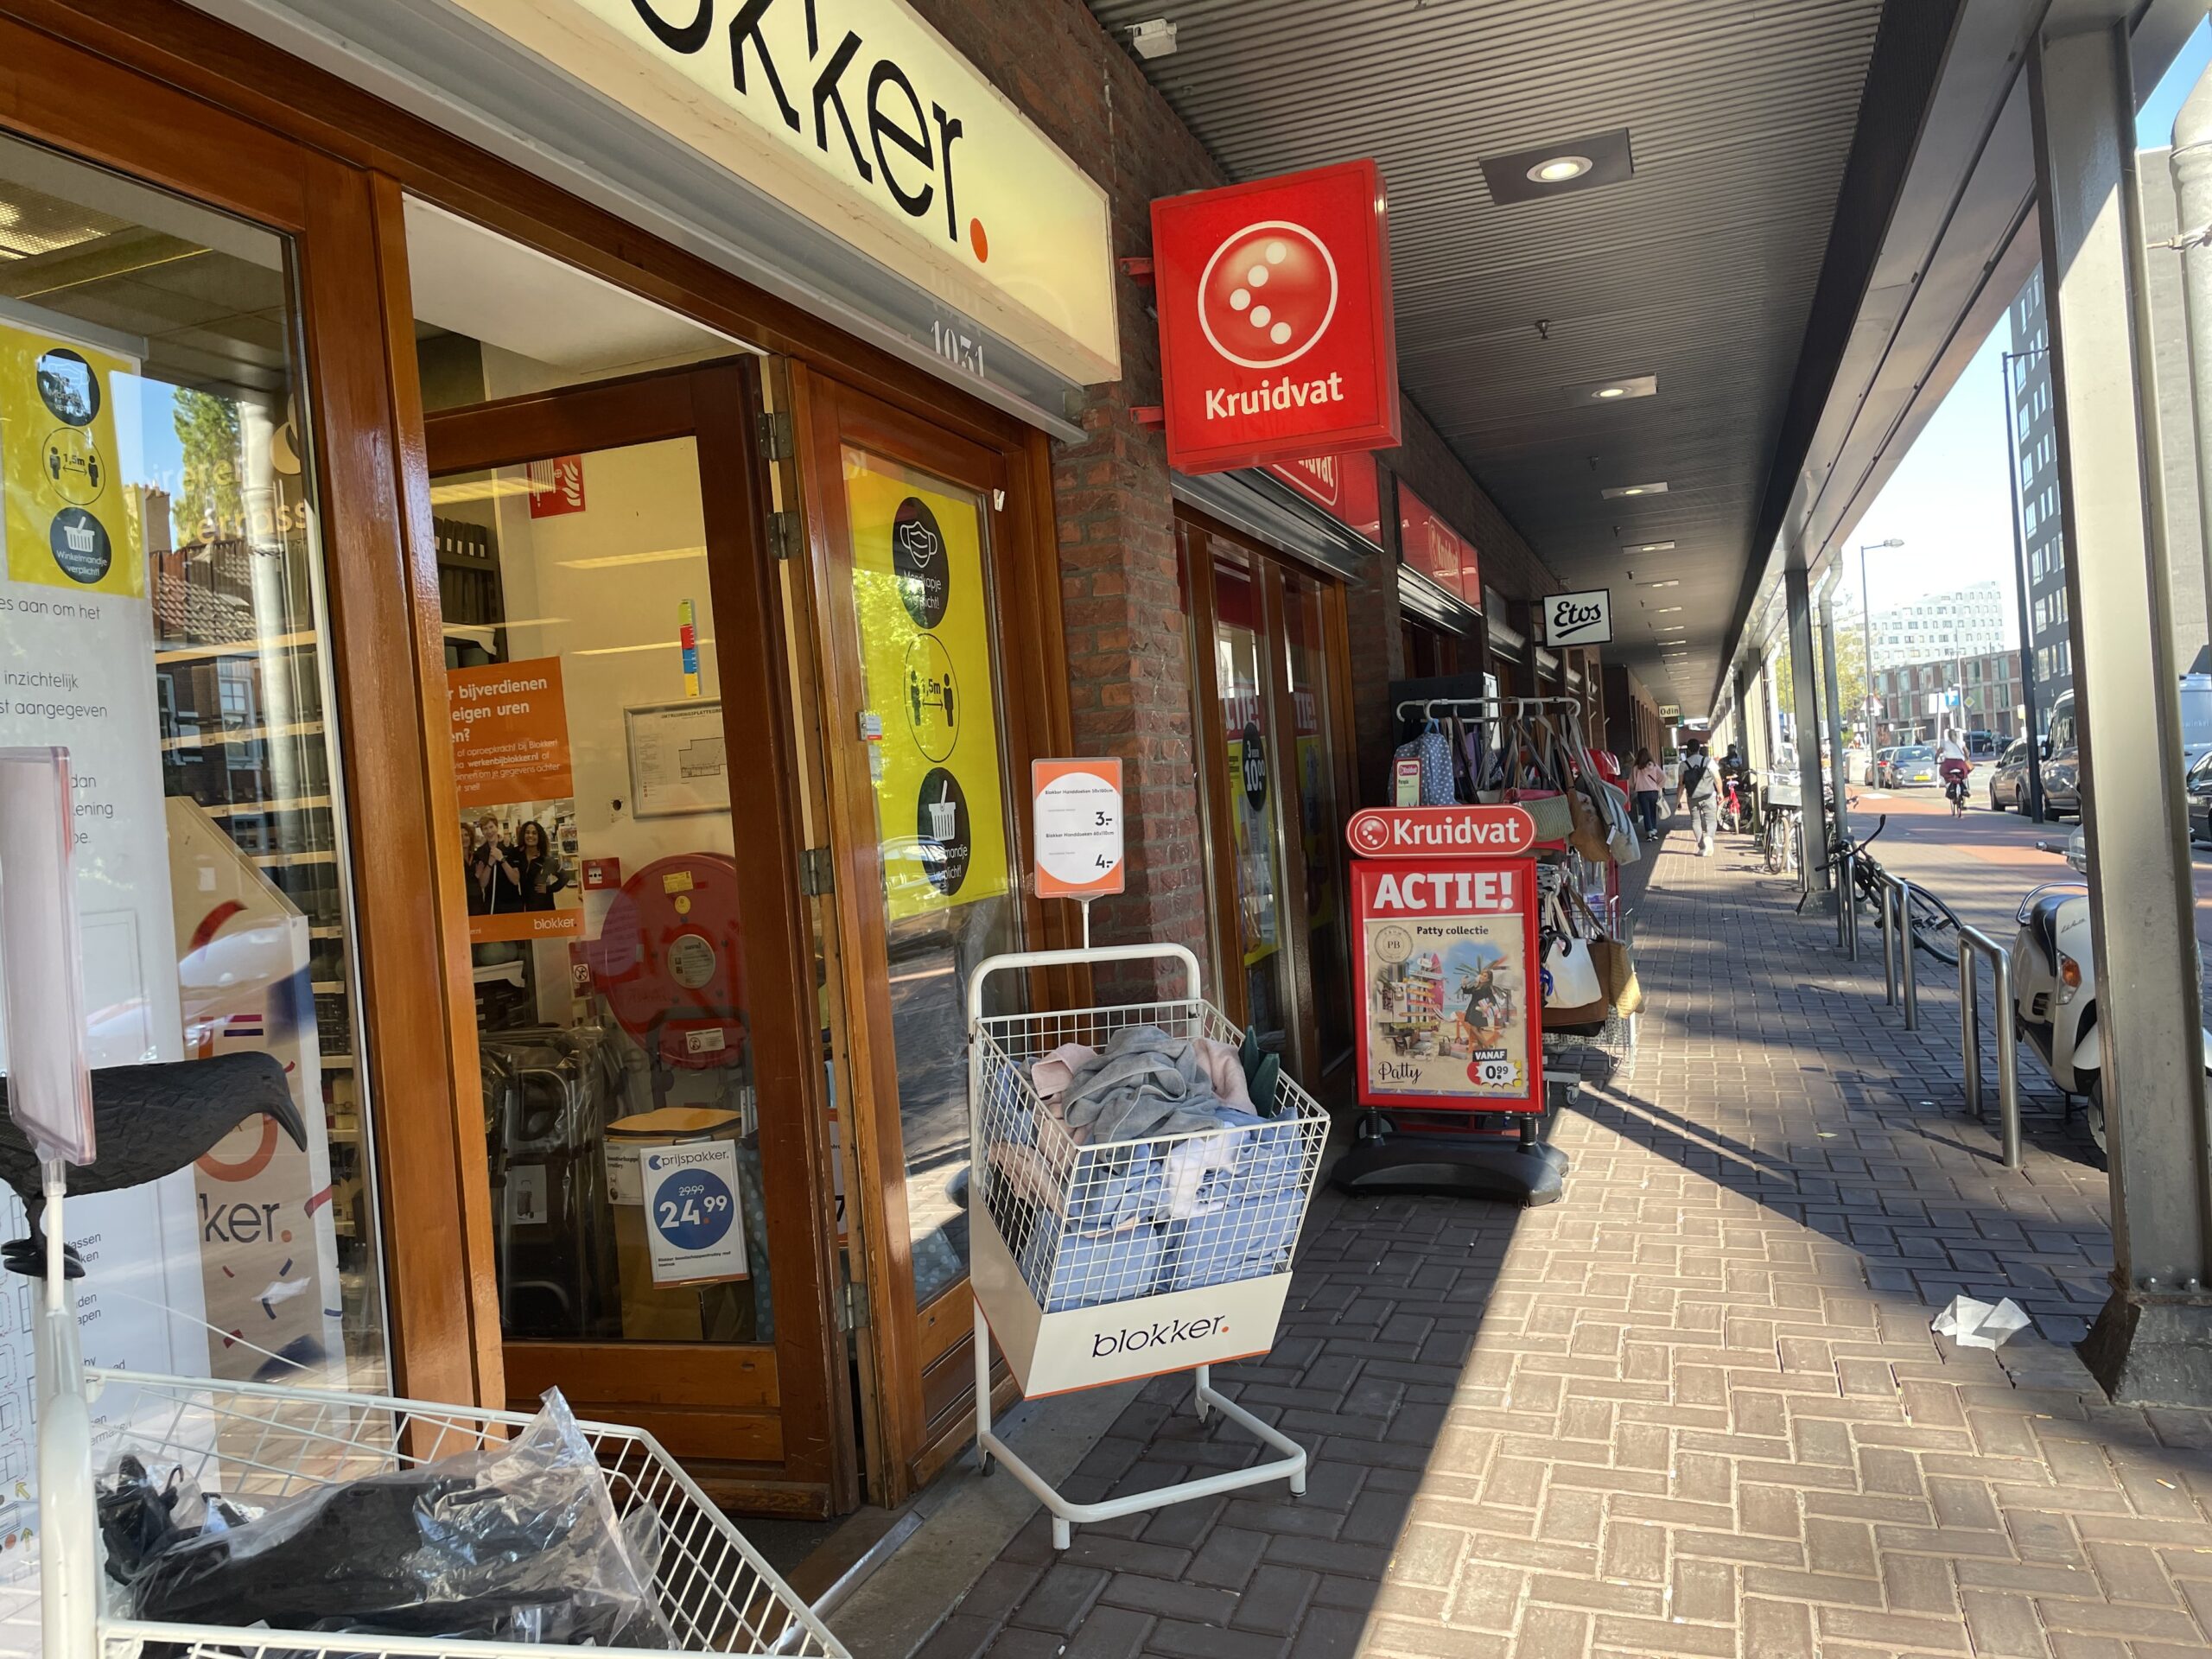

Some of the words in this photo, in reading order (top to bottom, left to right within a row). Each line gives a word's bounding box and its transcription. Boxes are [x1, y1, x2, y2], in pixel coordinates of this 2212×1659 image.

[1205, 372, 1344, 420] Kruidvat
[63, 453, 85, 467] 1,5m
[56, 550, 107, 567] Winkelmandje
[18, 600, 48, 614] aan
[52, 603, 75, 616] om
[79, 605, 101, 620] het
[1554, 601, 1602, 627] Etos
[4, 671, 79, 691] inzichtelijk
[458, 677, 548, 701] bijverdienen
[921, 678, 941, 696] 1,5m
[15, 702, 108, 720] aangegeven
[452, 707, 492, 723] eigen
[497, 702, 530, 716] uren
[1660, 707, 1679, 715] Odin
[457, 748, 465, 757] of
[467, 743, 516, 757] oproepkracht
[518, 742, 527, 752] bij
[529, 739, 558, 749] Blokker!
[467, 753, 539, 767] werkenbijblokker.nl
[541, 751, 550, 760] of
[499, 766, 536, 779] gegevens
[536, 762, 561, 772] achter
[73, 800, 114, 818] ening
[1394, 816, 1521, 846] Kruidvat
[1373, 871, 1514, 911] ACTIE!
[533, 917, 577, 930] blokker.
[1416, 925, 1445, 937] Patty
[1446, 925, 1490, 935] collectie
[1475, 1051, 1506, 1061] VANAF
[1378, 1061, 1424, 1084] Patty
[662, 1151, 729, 1167] prijspakker.
[199, 1193, 292, 1243] ker.
[68, 1233, 102, 1249] assen
[79, 1250, 99, 1263] ken
[1091, 1313, 1230, 1358] blokker.
